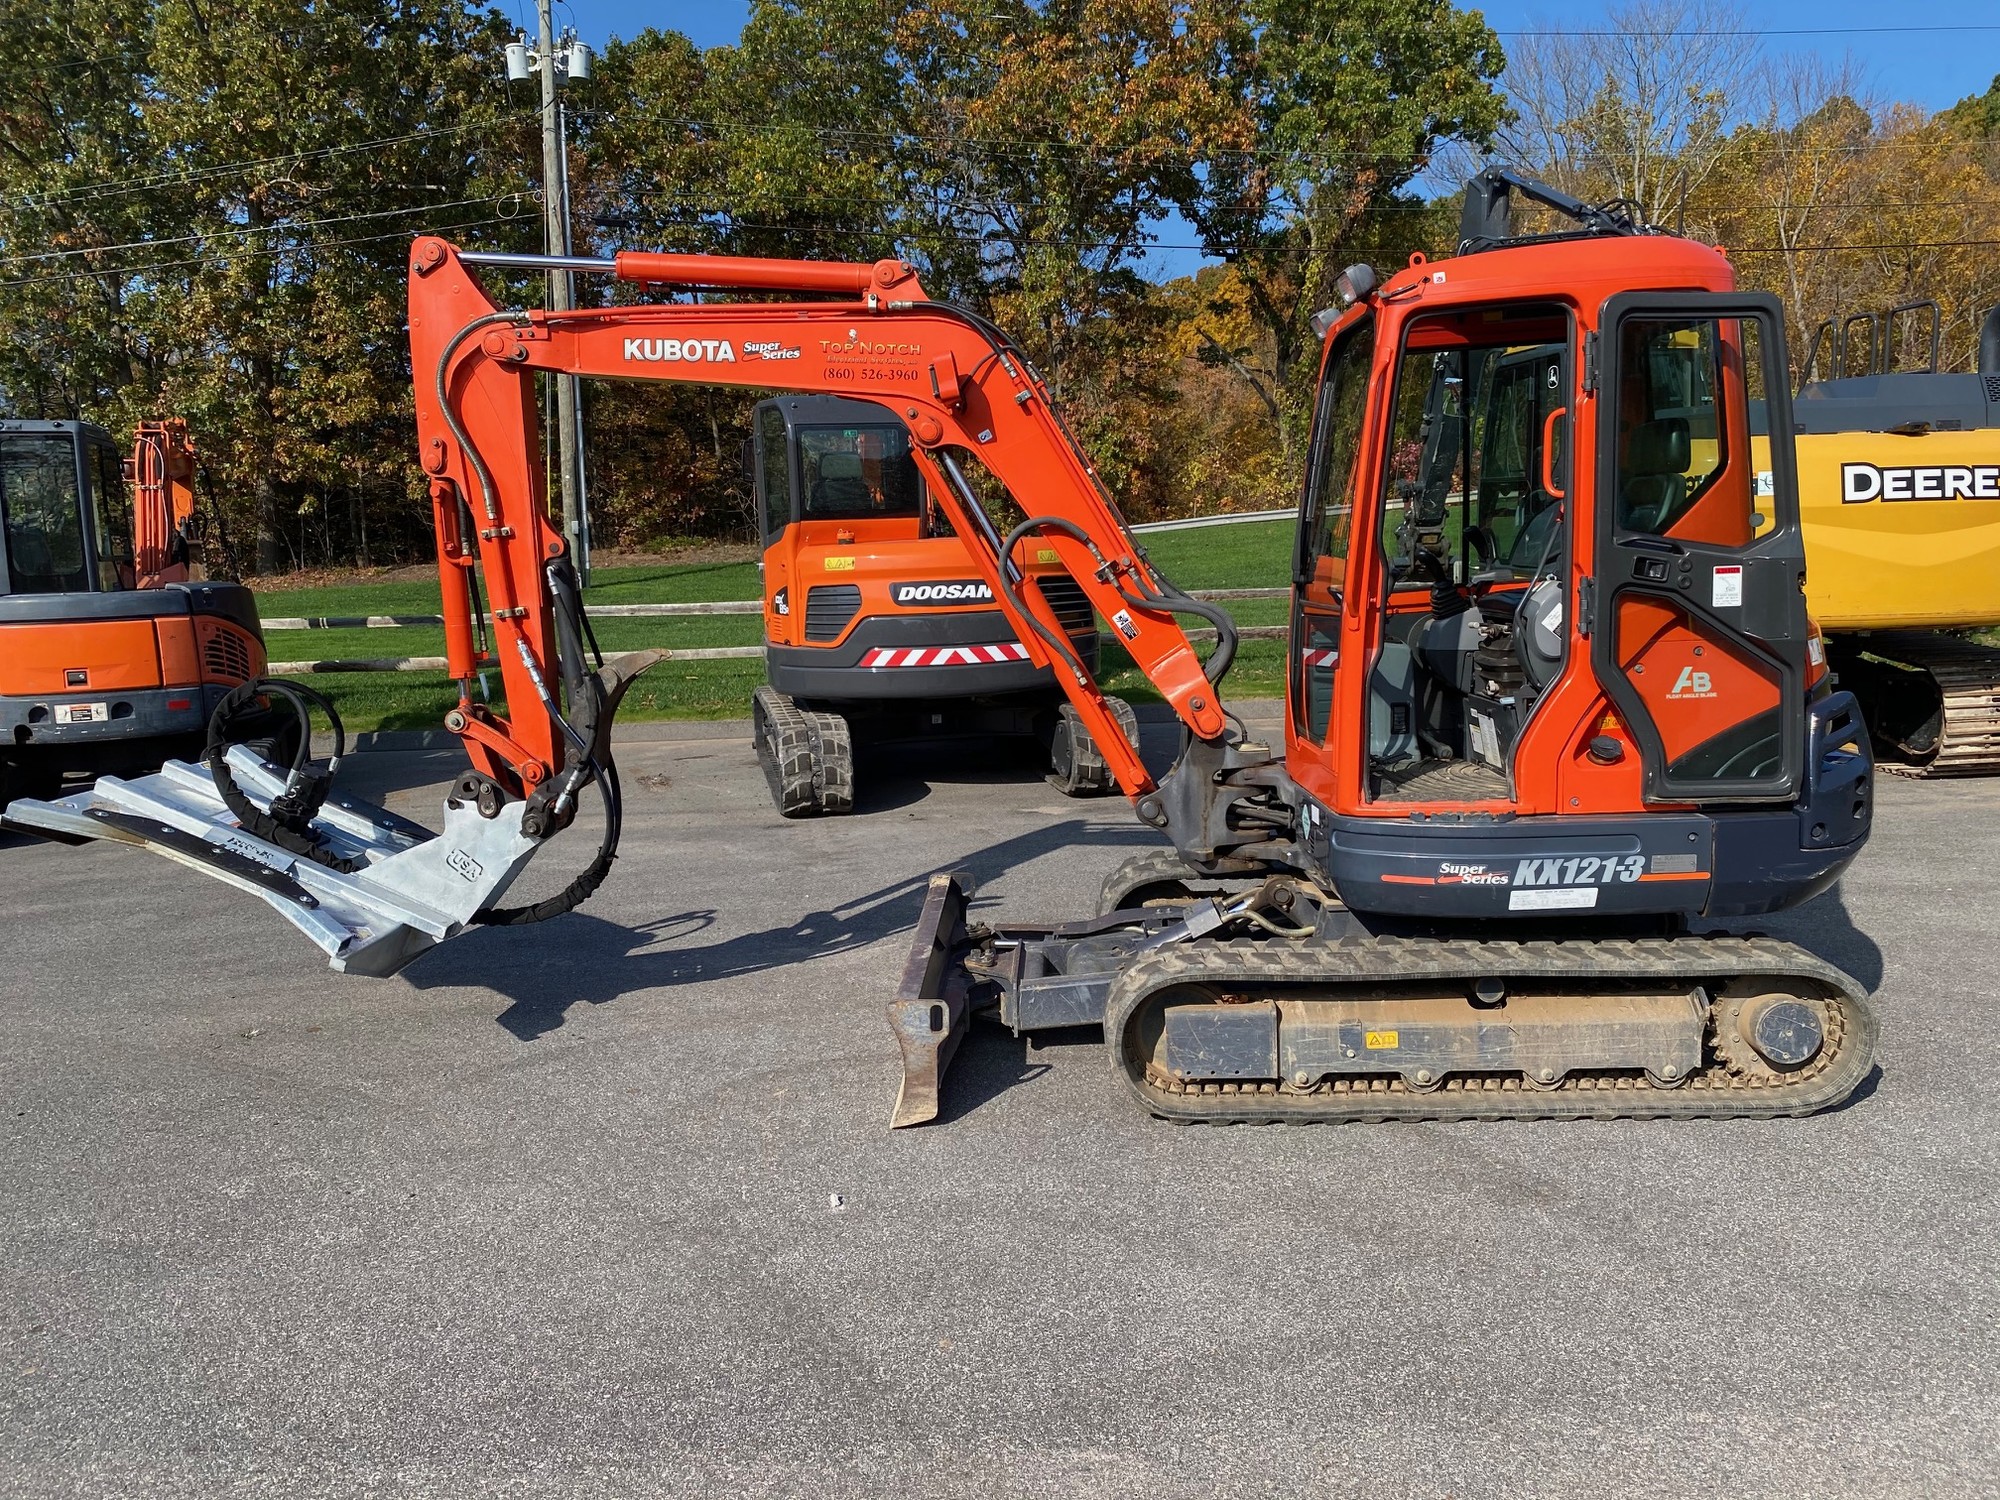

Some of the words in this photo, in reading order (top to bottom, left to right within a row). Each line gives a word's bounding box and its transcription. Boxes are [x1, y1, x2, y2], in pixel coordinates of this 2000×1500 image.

[623, 338, 736, 362] KUBOTA
[743, 341, 780, 354] Super
[761, 348, 801, 360] Series
[819, 340, 855, 354] TOP
[859, 341, 922, 356] NOTCH
[823, 367, 855, 381] (860)
[860, 368, 919, 381] 526-3960
[1842, 463, 2000, 503] DEERE
[898, 585, 992, 600] DOOSAN
[453, 854, 476, 878] USA
[1439, 862, 1487, 877] Super
[1512, 855, 1646, 886] KX121-3
[1461, 873, 1509, 885] Series
